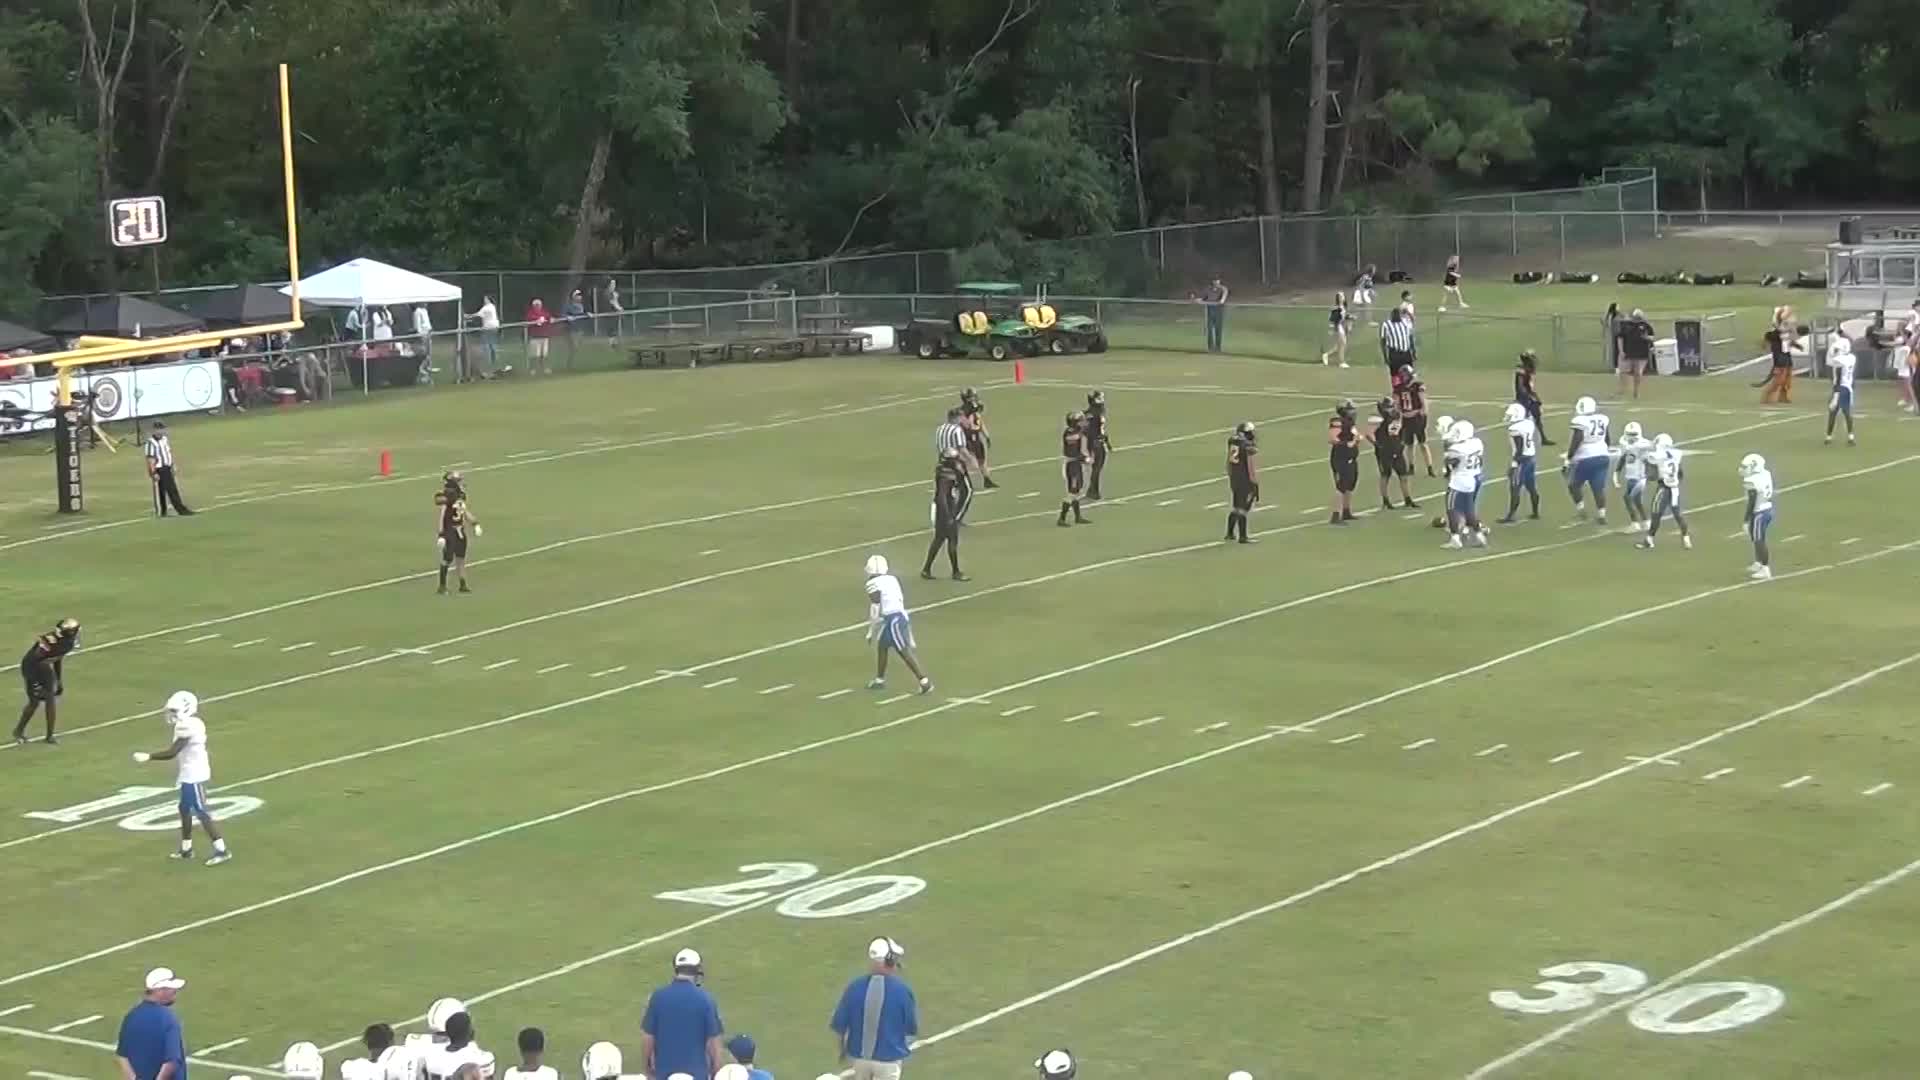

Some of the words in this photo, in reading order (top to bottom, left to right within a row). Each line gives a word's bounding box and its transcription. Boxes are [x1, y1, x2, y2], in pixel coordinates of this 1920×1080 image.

[116, 201, 159, 241] 20
[653, 862, 927, 918] 20
[1489, 961, 1785, 1034] 30
